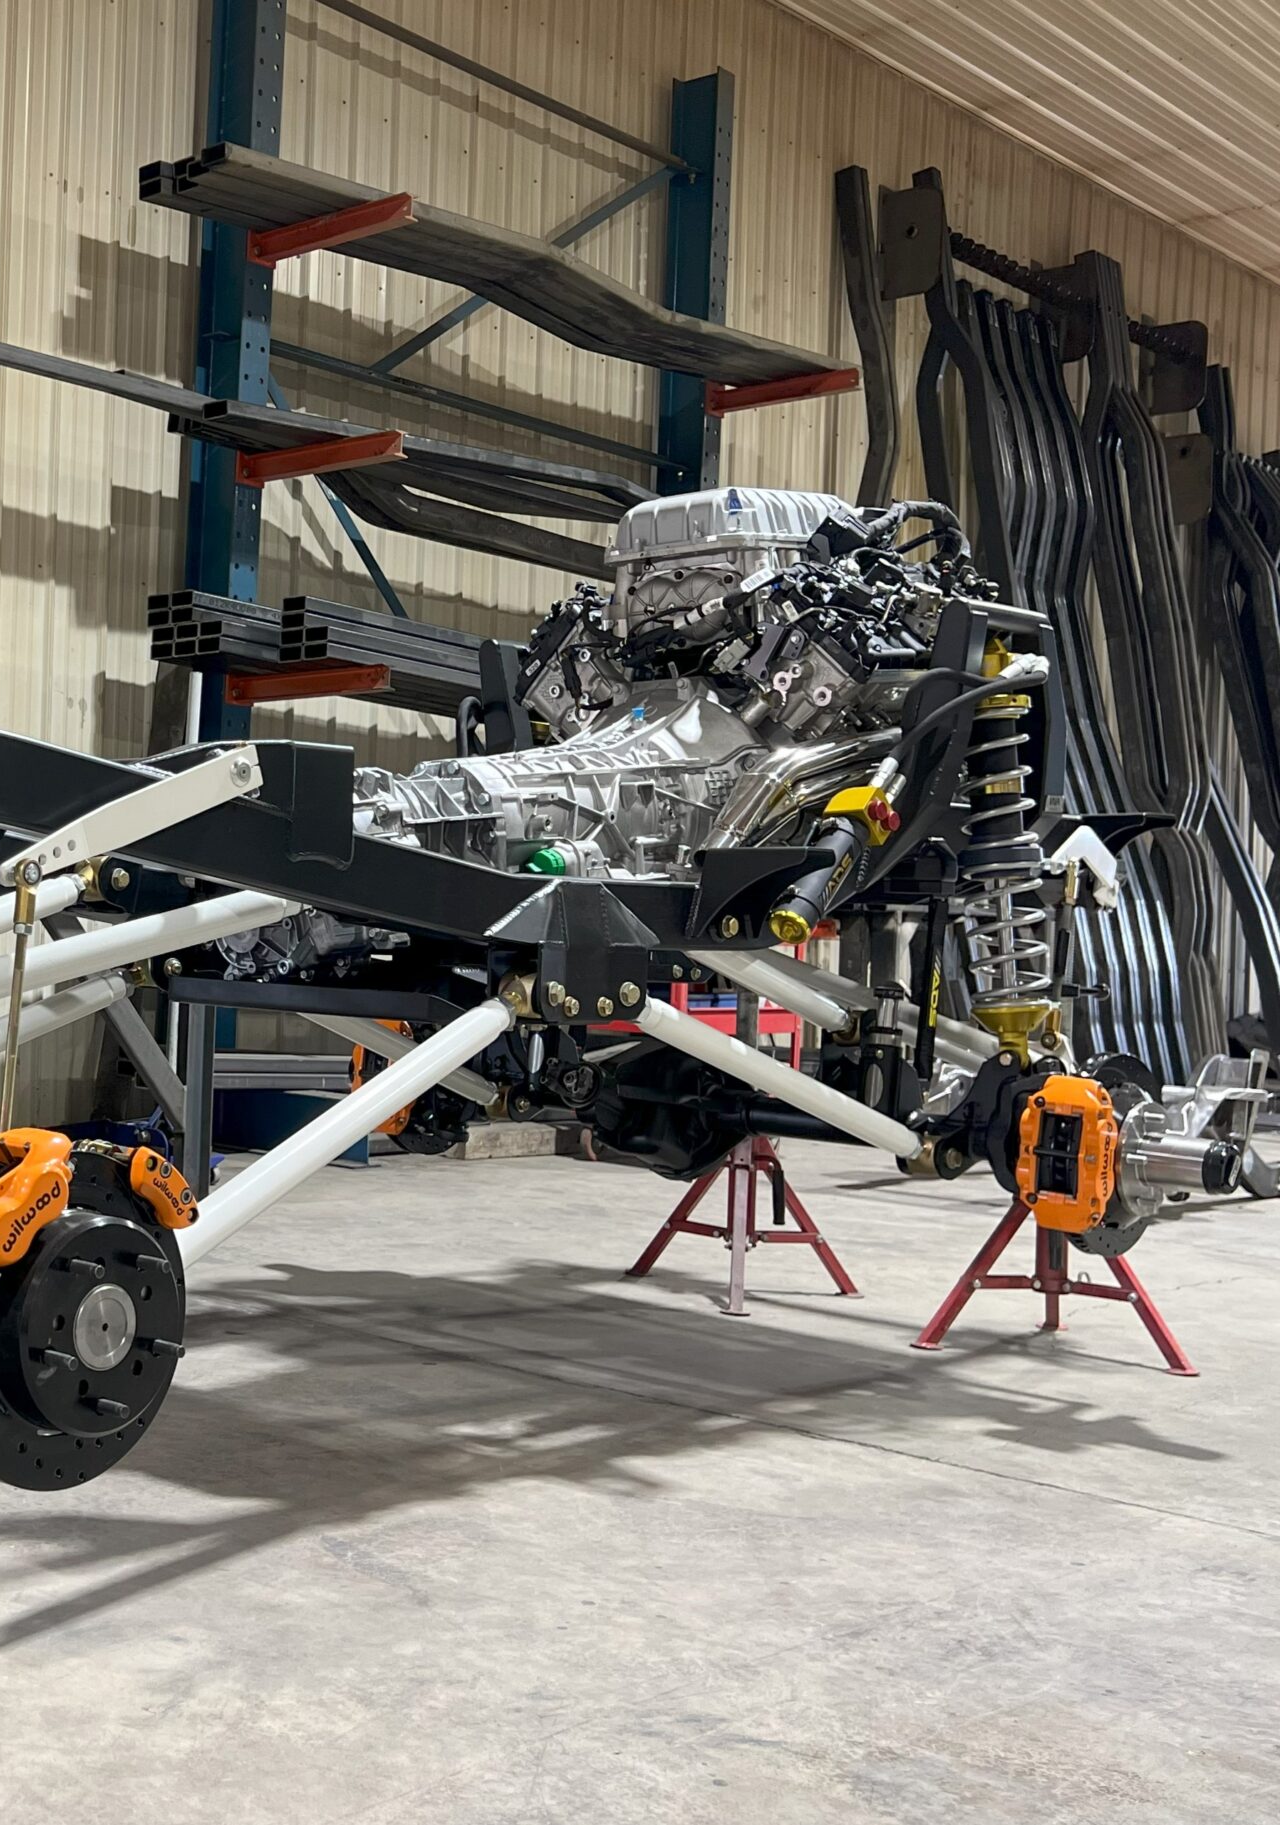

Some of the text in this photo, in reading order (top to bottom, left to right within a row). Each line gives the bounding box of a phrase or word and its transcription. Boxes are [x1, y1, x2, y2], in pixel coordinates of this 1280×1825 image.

[1100, 1121, 1113, 1197] wilwood
[2, 1180, 61, 1253] wilwood
[152, 1177, 185, 1216] wilwood
